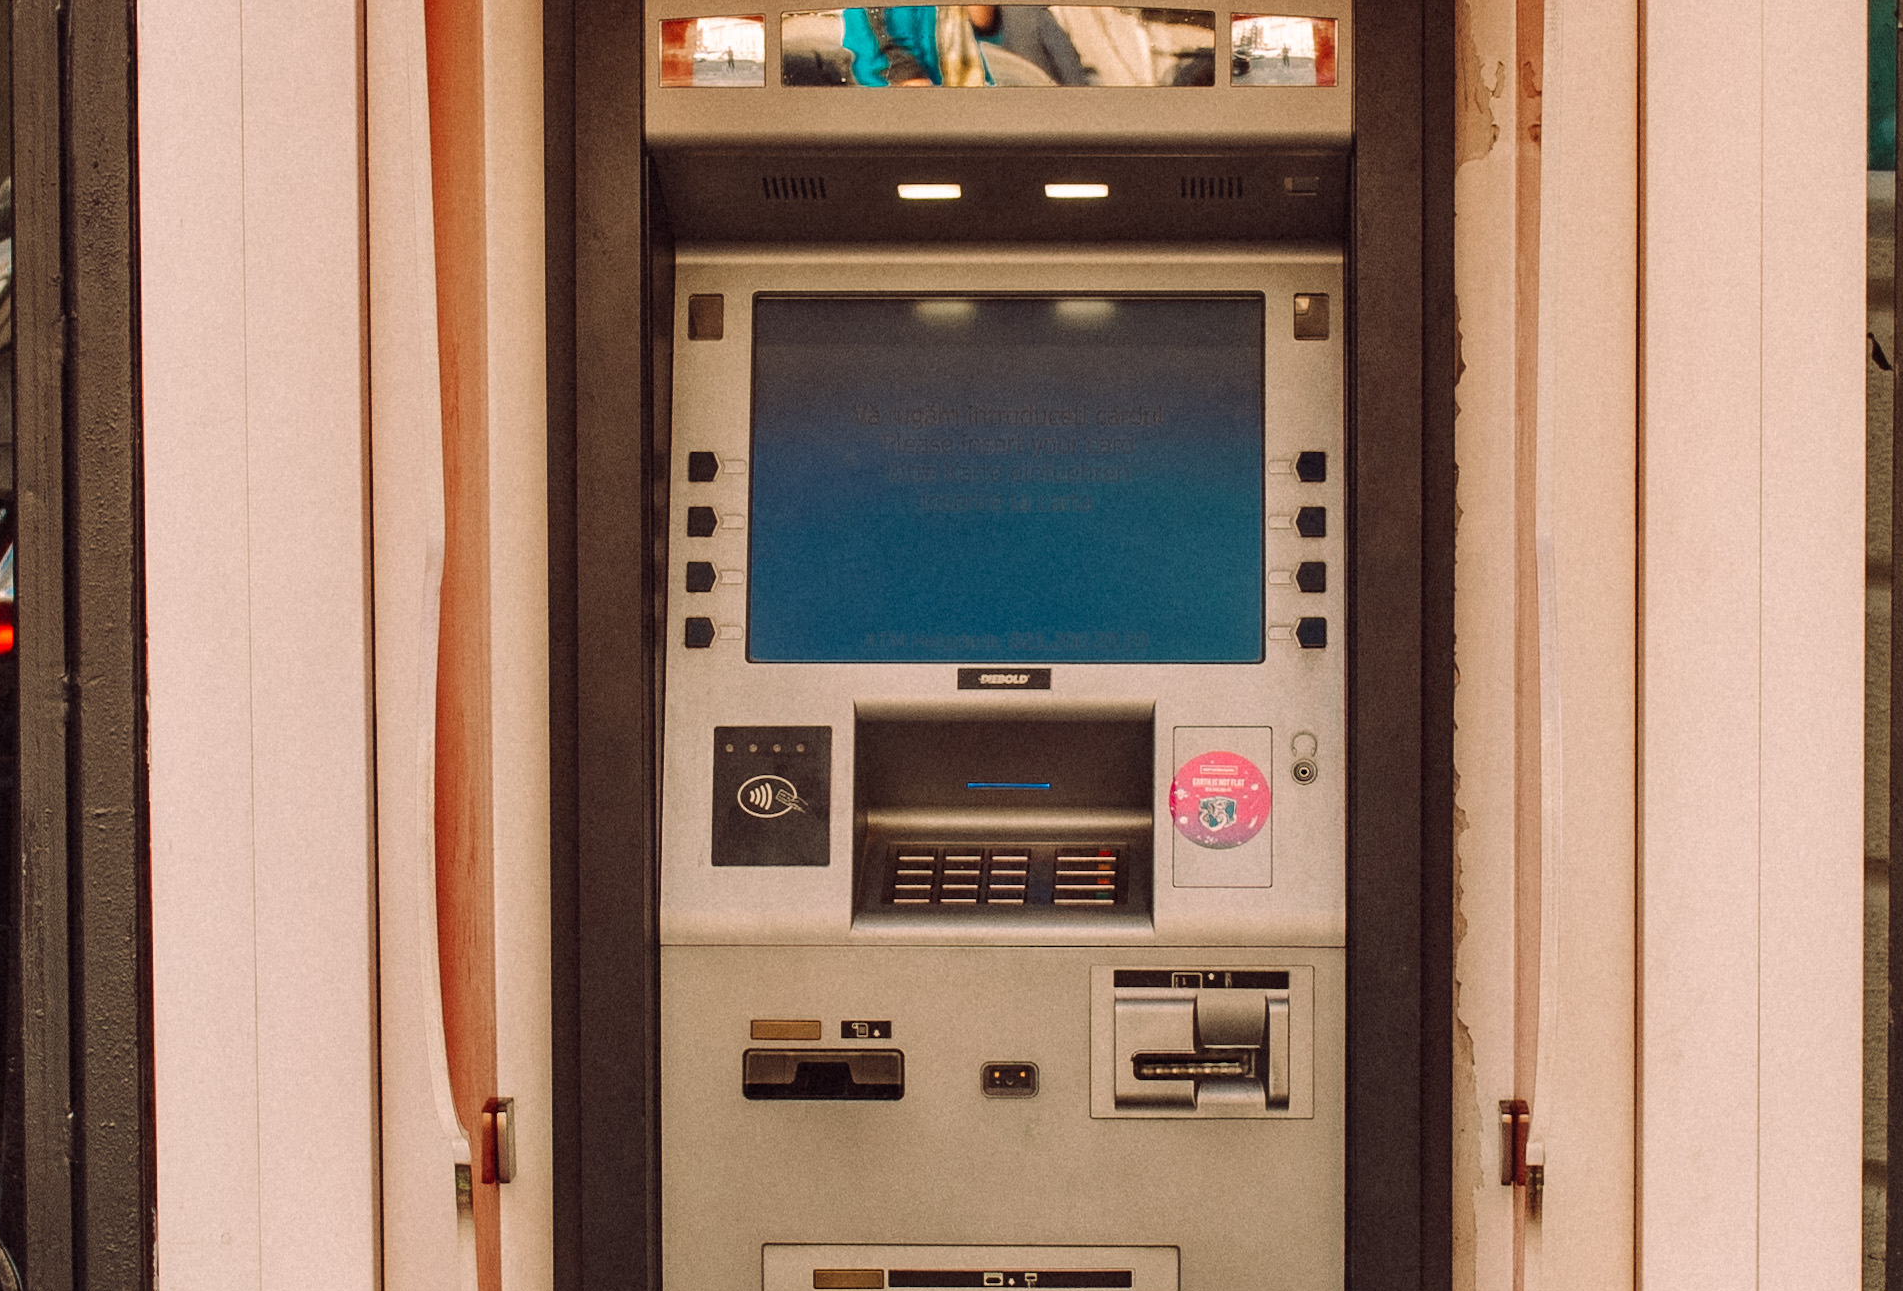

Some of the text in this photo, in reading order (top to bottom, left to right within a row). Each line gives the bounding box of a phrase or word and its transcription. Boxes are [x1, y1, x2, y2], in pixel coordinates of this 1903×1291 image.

[1095, 404, 1165, 427] cardul
[882, 432, 1136, 459] Please insert your card
[884, 461, 938, 484] Bitte
[945, 461, 1003, 484] Karte
[920, 490, 1095, 513] Inserire la carta
[980, 674, 1029, 684] DIEBOLD
